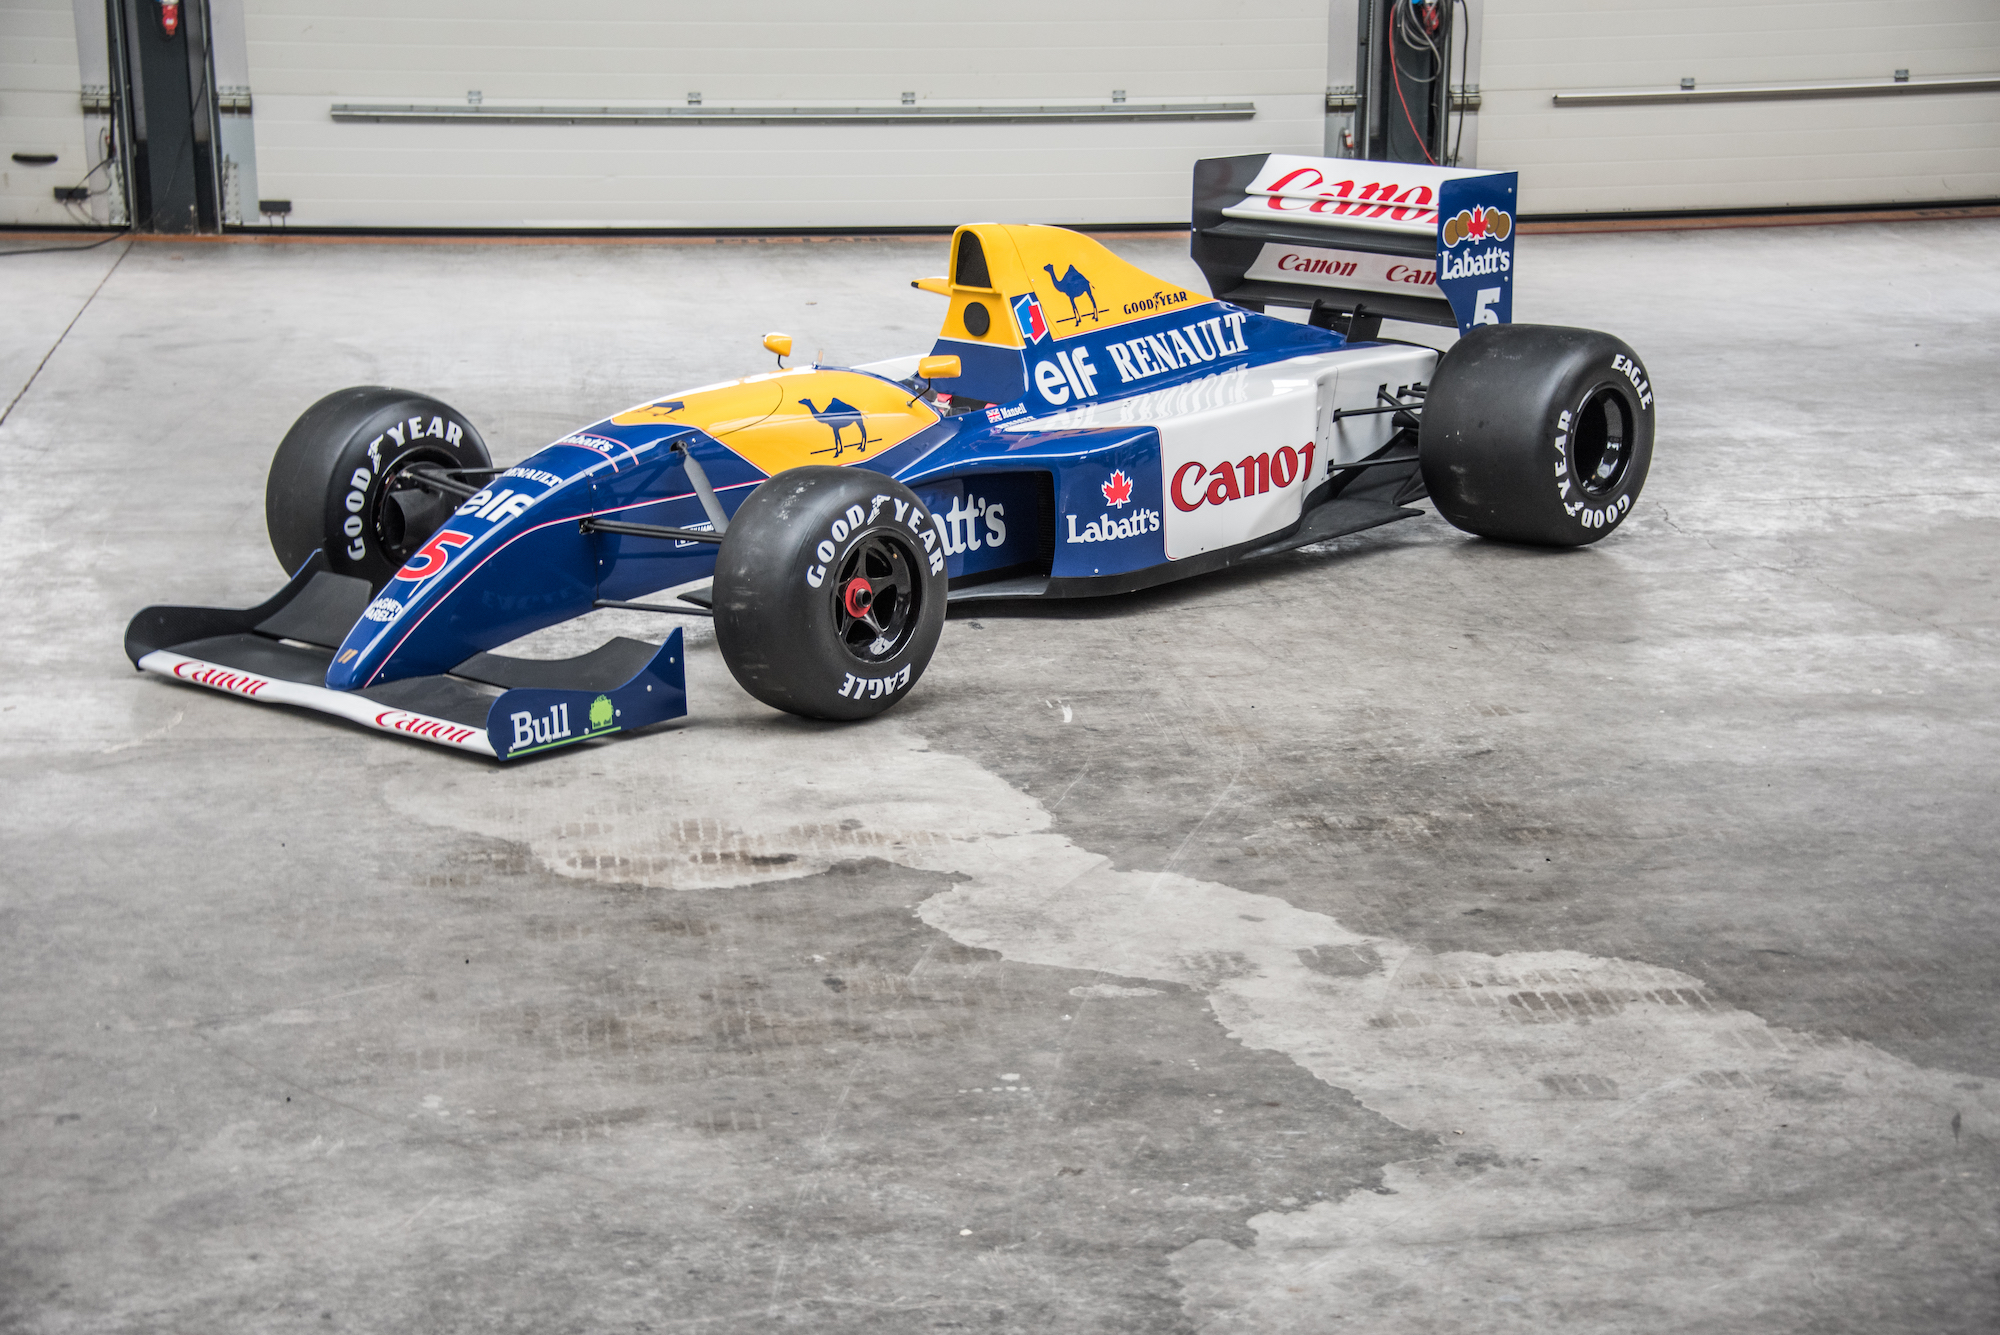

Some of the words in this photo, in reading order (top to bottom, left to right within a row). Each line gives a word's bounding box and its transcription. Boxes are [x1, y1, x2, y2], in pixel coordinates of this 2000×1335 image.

[1266, 168, 1438, 223] Cano
[1277, 254, 1358, 277] Canon
[1441, 247, 1510, 280] Labatt's
[1473, 287, 1501, 326] 5
[1034, 346, 1099, 405] elf
[1105, 312, 1249, 383] RENAULT
[1611, 354, 1652, 410] EAGLE
[1000, 402, 1027, 419] Mansell
[455, 489, 535, 523] elf
[1066, 508, 1160, 543] Labatt's
[395, 529, 474, 581] 5
[173, 660, 269, 696] Canon
[838, 663, 911, 700] EAGLE
[375, 710, 476, 744] Canon
[510, 703, 571, 749] Bull
